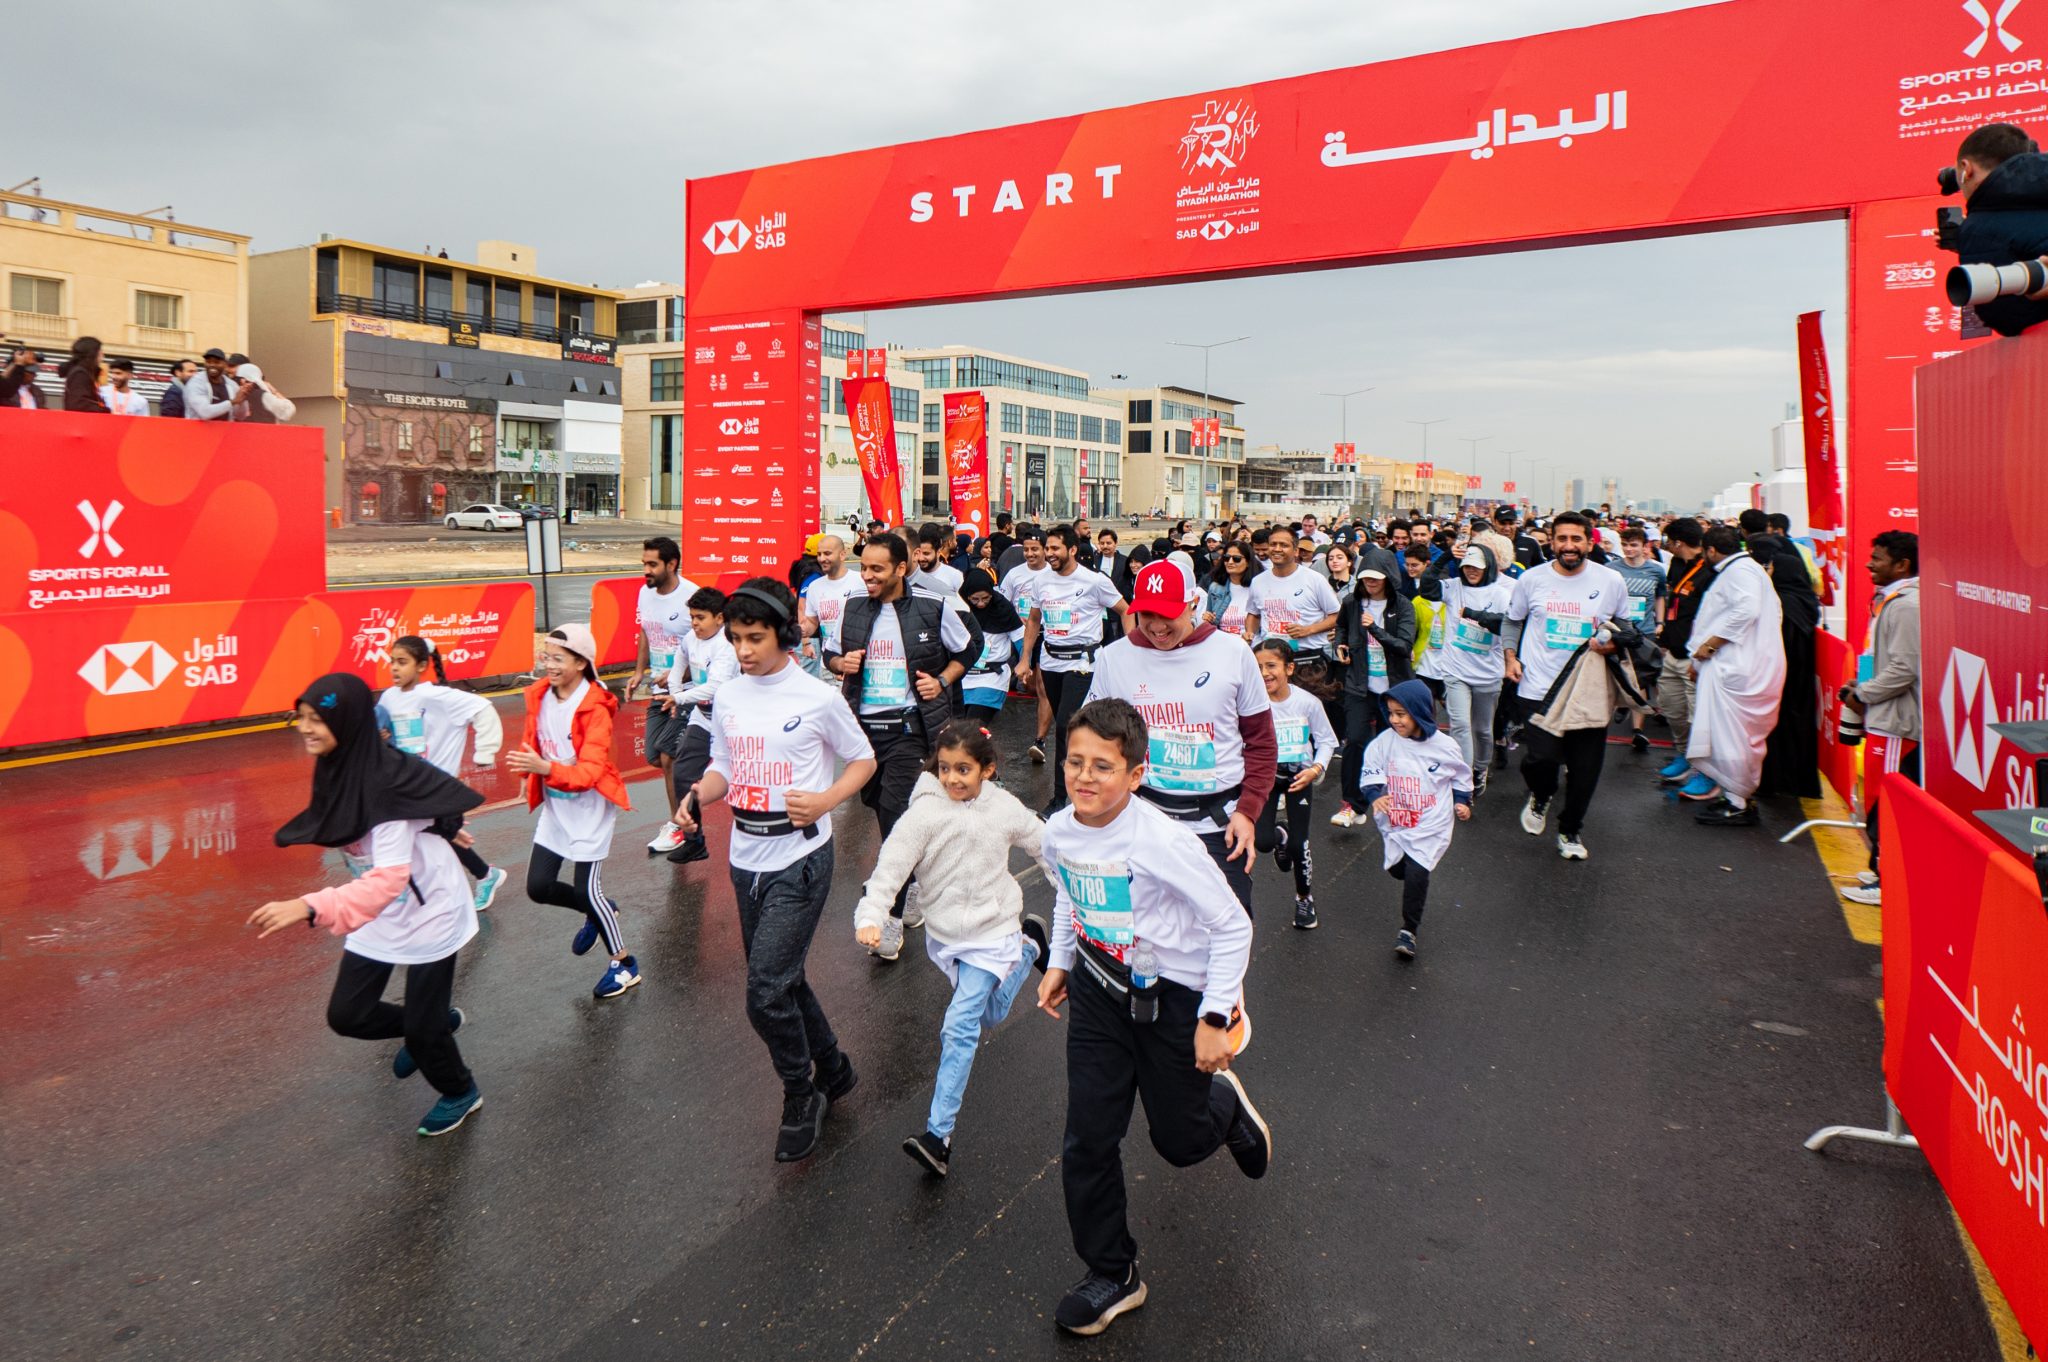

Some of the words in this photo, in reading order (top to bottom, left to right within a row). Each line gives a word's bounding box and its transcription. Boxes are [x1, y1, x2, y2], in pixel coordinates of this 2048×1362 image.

[1899, 66, 1991, 90] SPORTS
[1995, 59, 2042, 76] FOR
[1898, 86, 1991, 116] للجميع
[1320, 89, 1627, 168] البداية
[909, 163, 1122, 223] START
[1177, 182, 1214, 198] الرياض
[1217, 177, 1260, 193] ماراثون
[1176, 195, 1209, 208] RIYADH
[1210, 189, 1260, 204] MARATHON
[754, 211, 787, 234] الأول
[1176, 213, 1207, 222] PRESENTED
[1207, 212, 1216, 220] BY
[1176, 229, 1198, 240] SAB
[1236, 221, 1260, 235] الأول
[754, 232, 787, 250] SAB
[384, 393, 404, 404] THE
[405, 395, 436, 407] ESCAPE
[437, 398, 469, 409] HOTEL
[744, 427, 759, 435] SAB
[731, 555, 749, 563] GSK
[761, 556, 778, 565] CALO
[28, 568, 102, 582] SPORTS
[103, 566, 137, 579] FOR
[138, 565, 171, 577] ALL
[28, 586, 102, 609] للجميع
[103, 584, 171, 599] الرياضة
[1956, 581, 1996, 605] PRESENTING
[1996, 588, 2032, 614] PARTNER
[418, 628, 452, 637] RIYADH
[452, 624, 499, 636] MARATHON
[183, 634, 238, 663] الأول
[184, 663, 238, 687] SAB
[2005, 755, 2036, 810] SA
